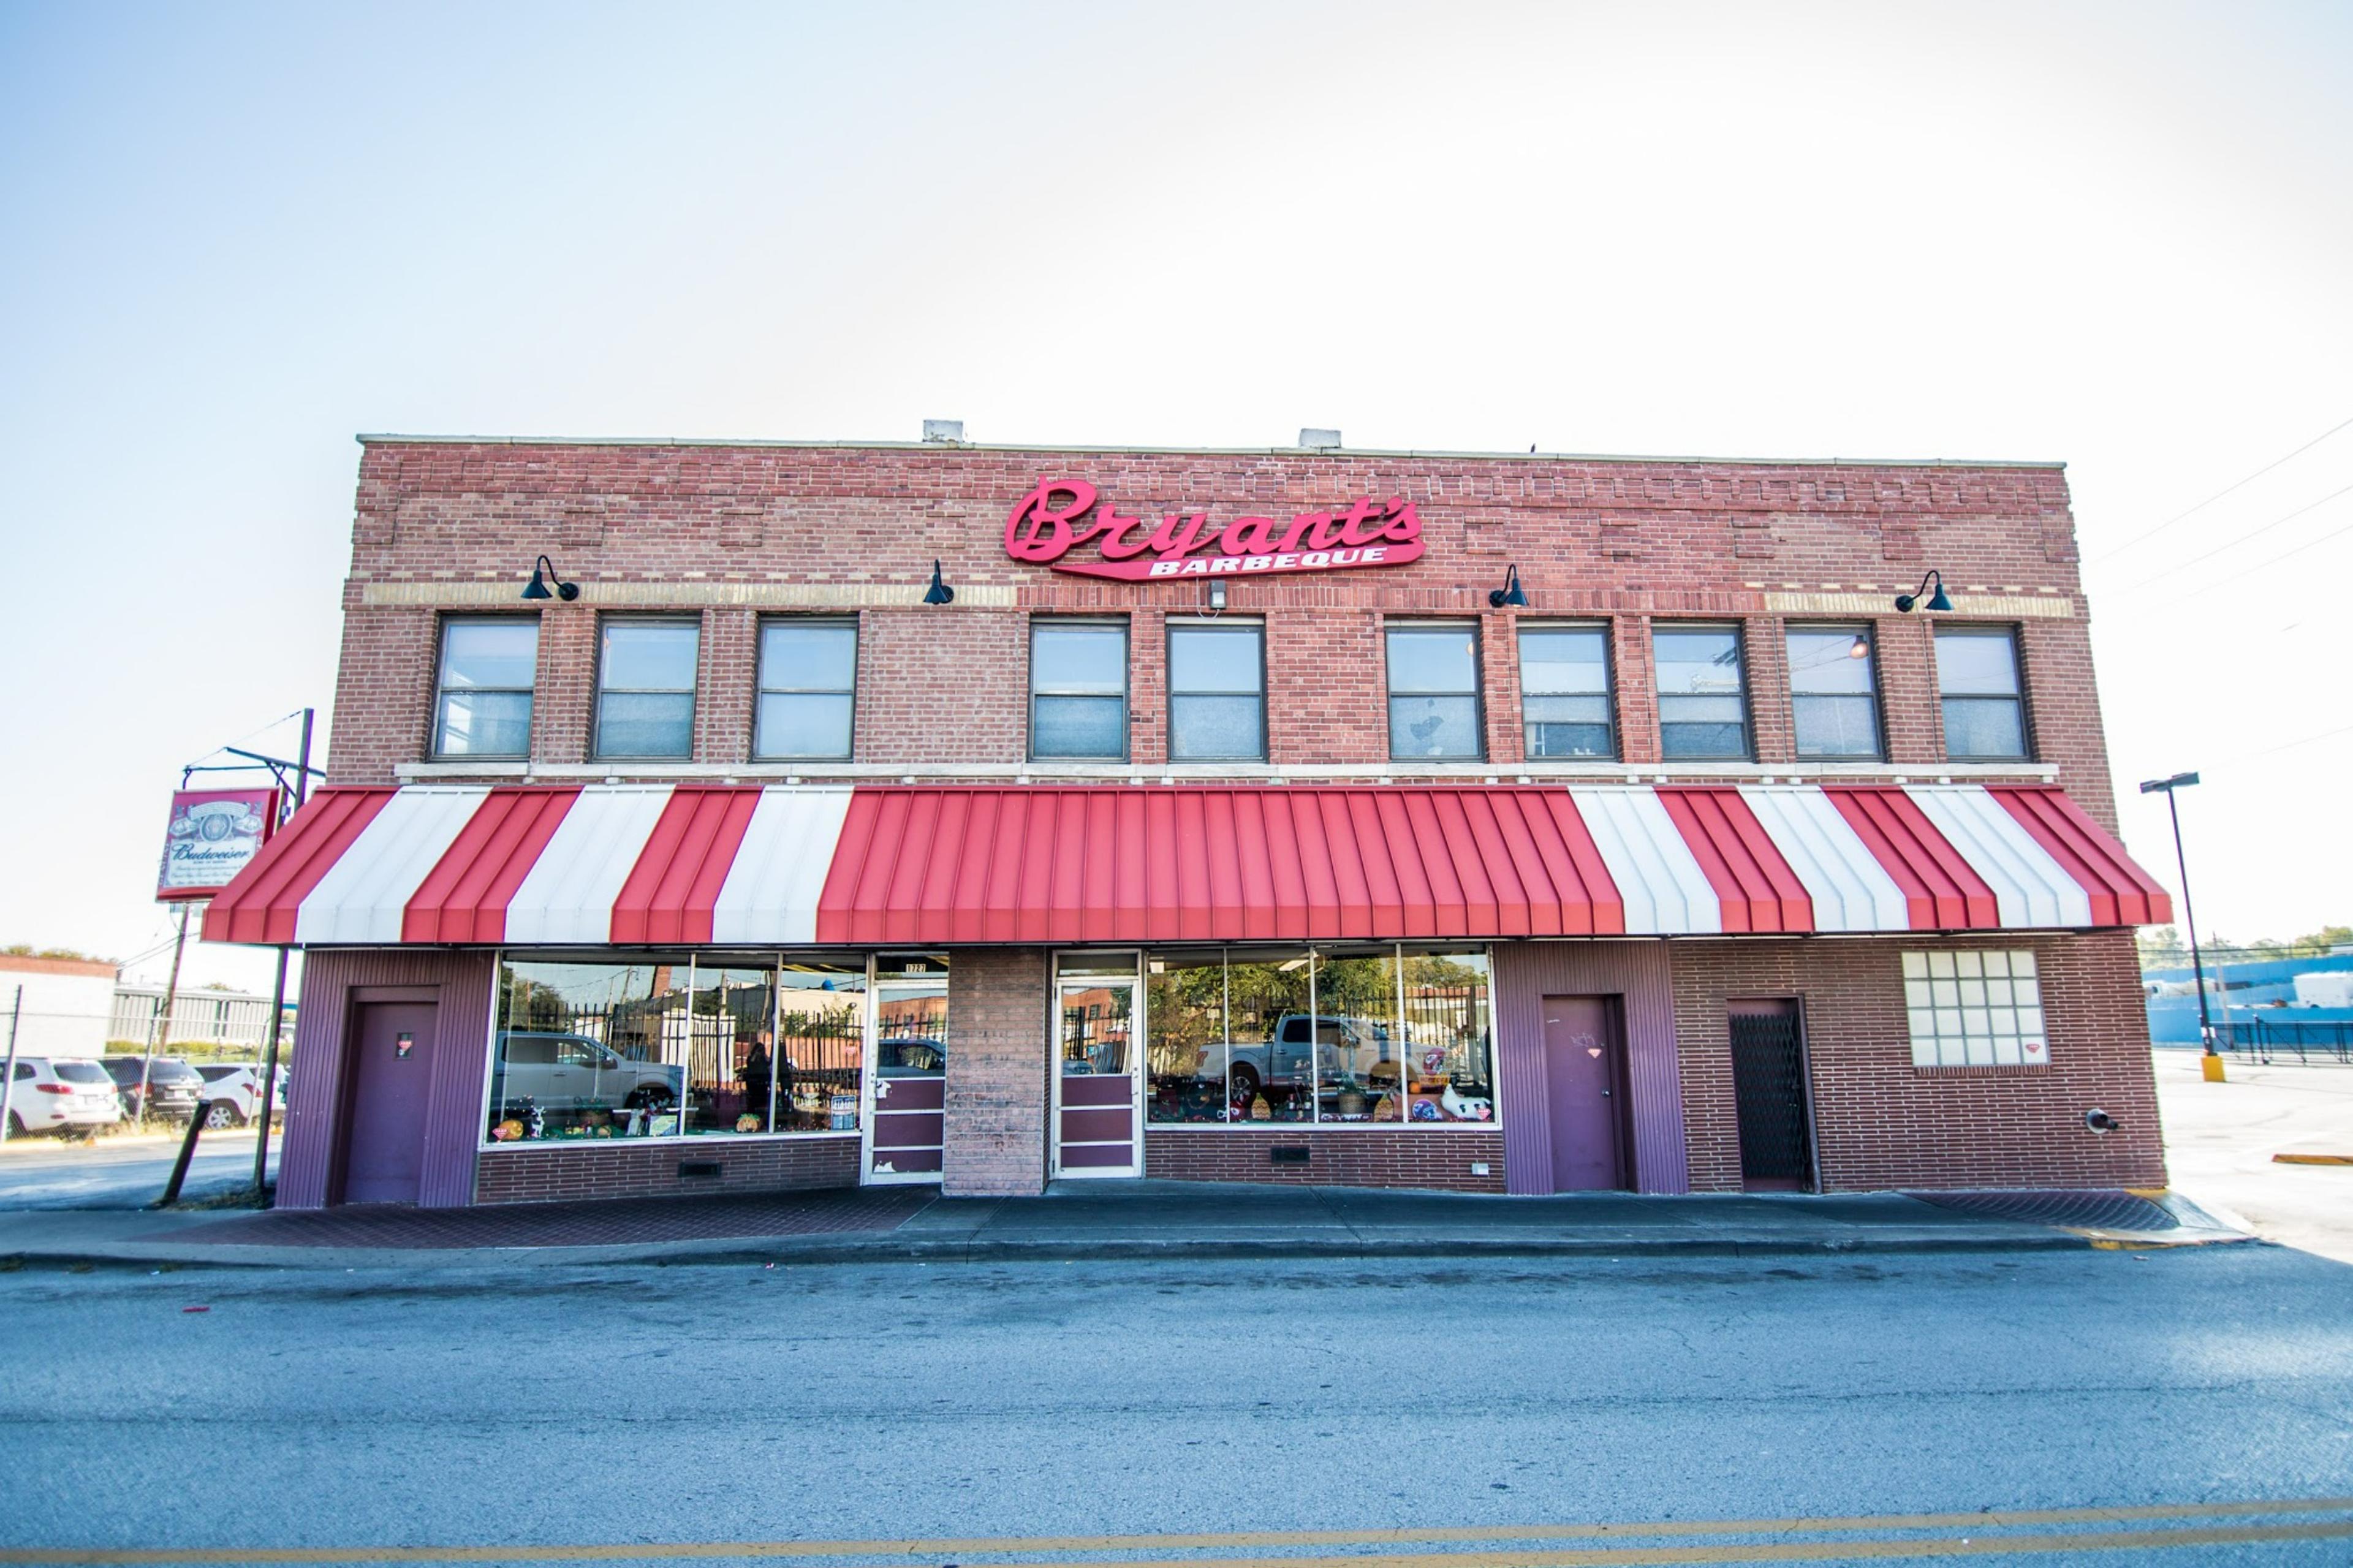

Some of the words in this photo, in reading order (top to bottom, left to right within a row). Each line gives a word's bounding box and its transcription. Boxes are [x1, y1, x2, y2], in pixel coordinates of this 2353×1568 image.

[1005, 475, 1423, 564] Bryant's
[1149, 547, 1387, 576] BARBEQUE
[172, 843, 249, 860] Budweiser
